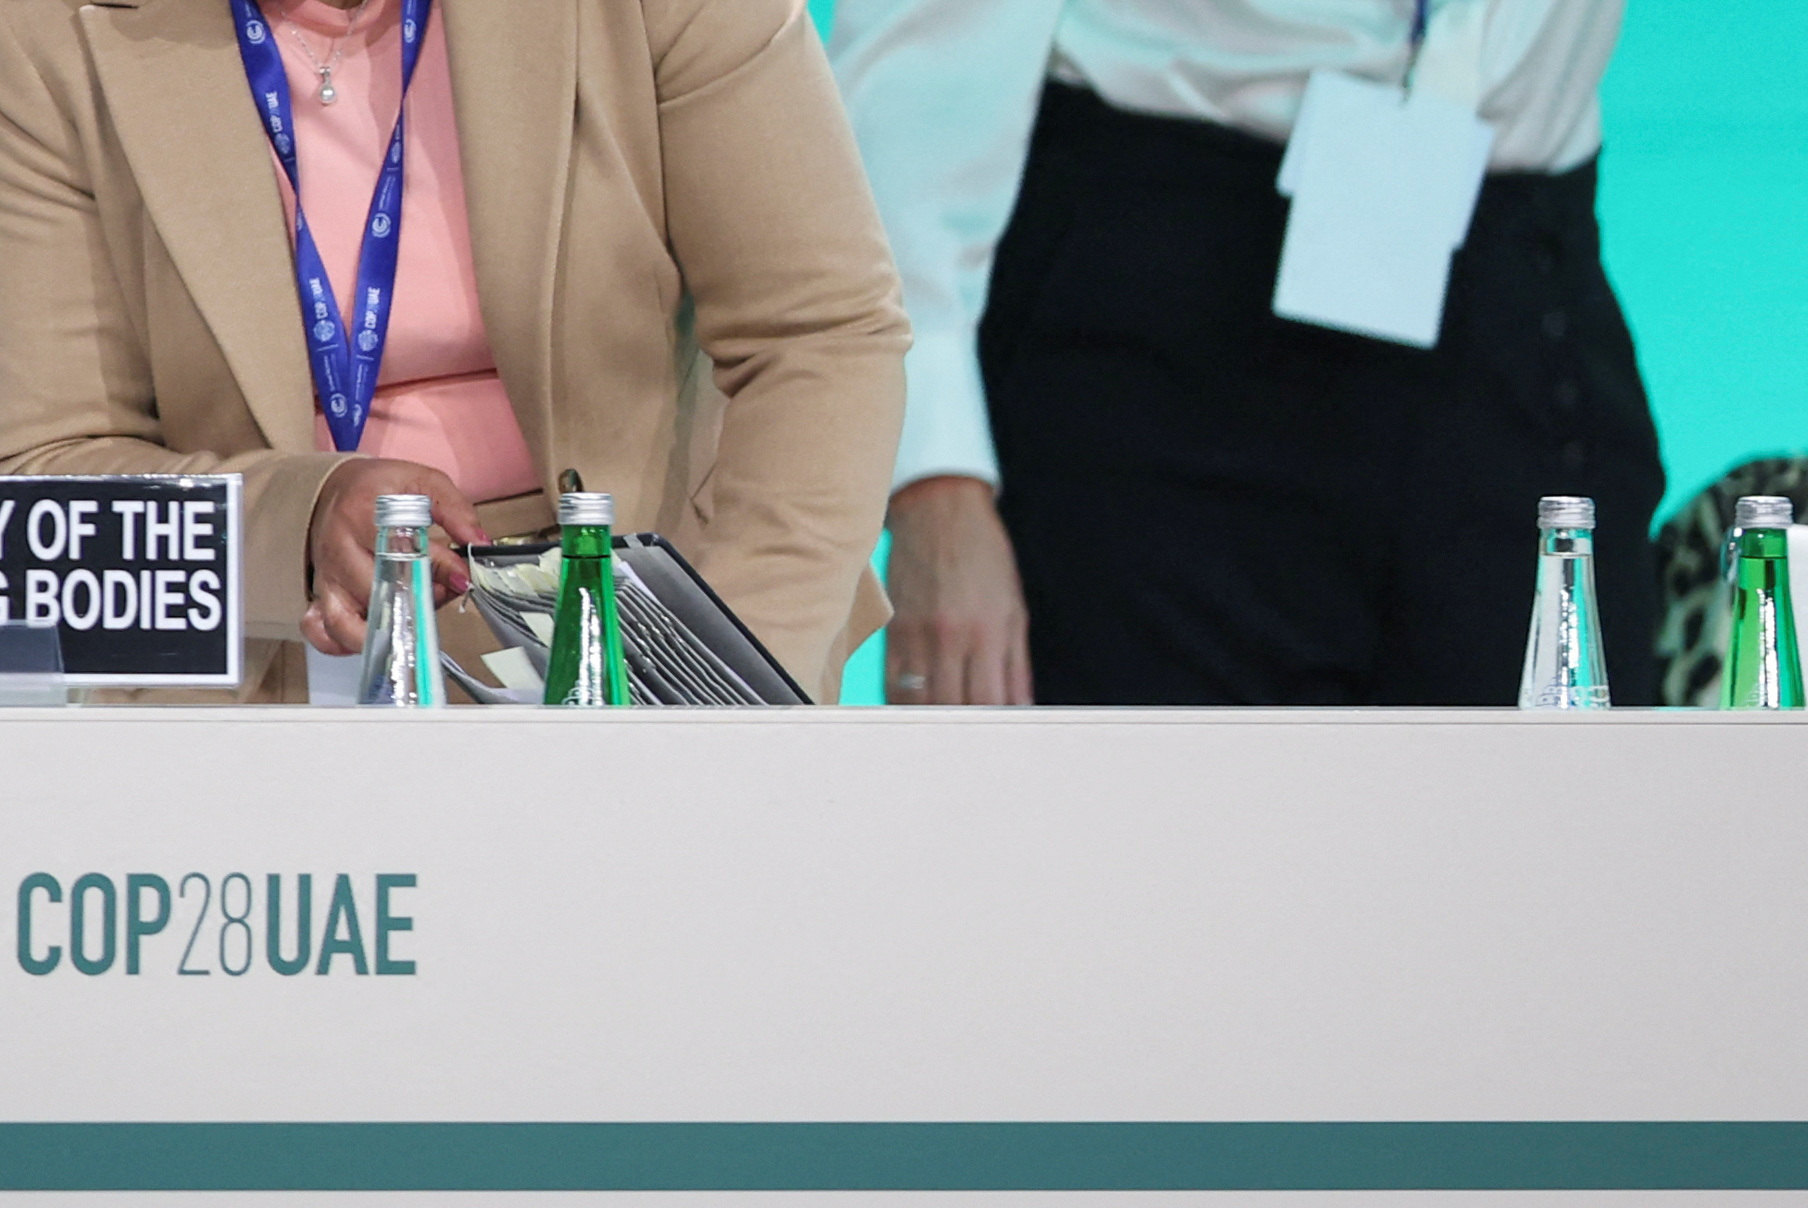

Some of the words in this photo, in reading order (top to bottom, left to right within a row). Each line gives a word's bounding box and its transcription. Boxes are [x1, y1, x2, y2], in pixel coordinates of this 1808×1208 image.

[26, 499, 98, 561] OF
[112, 499, 216, 561] THE
[24, 568, 222, 632] BODIES
[16, 871, 419, 977] COP28UAE
